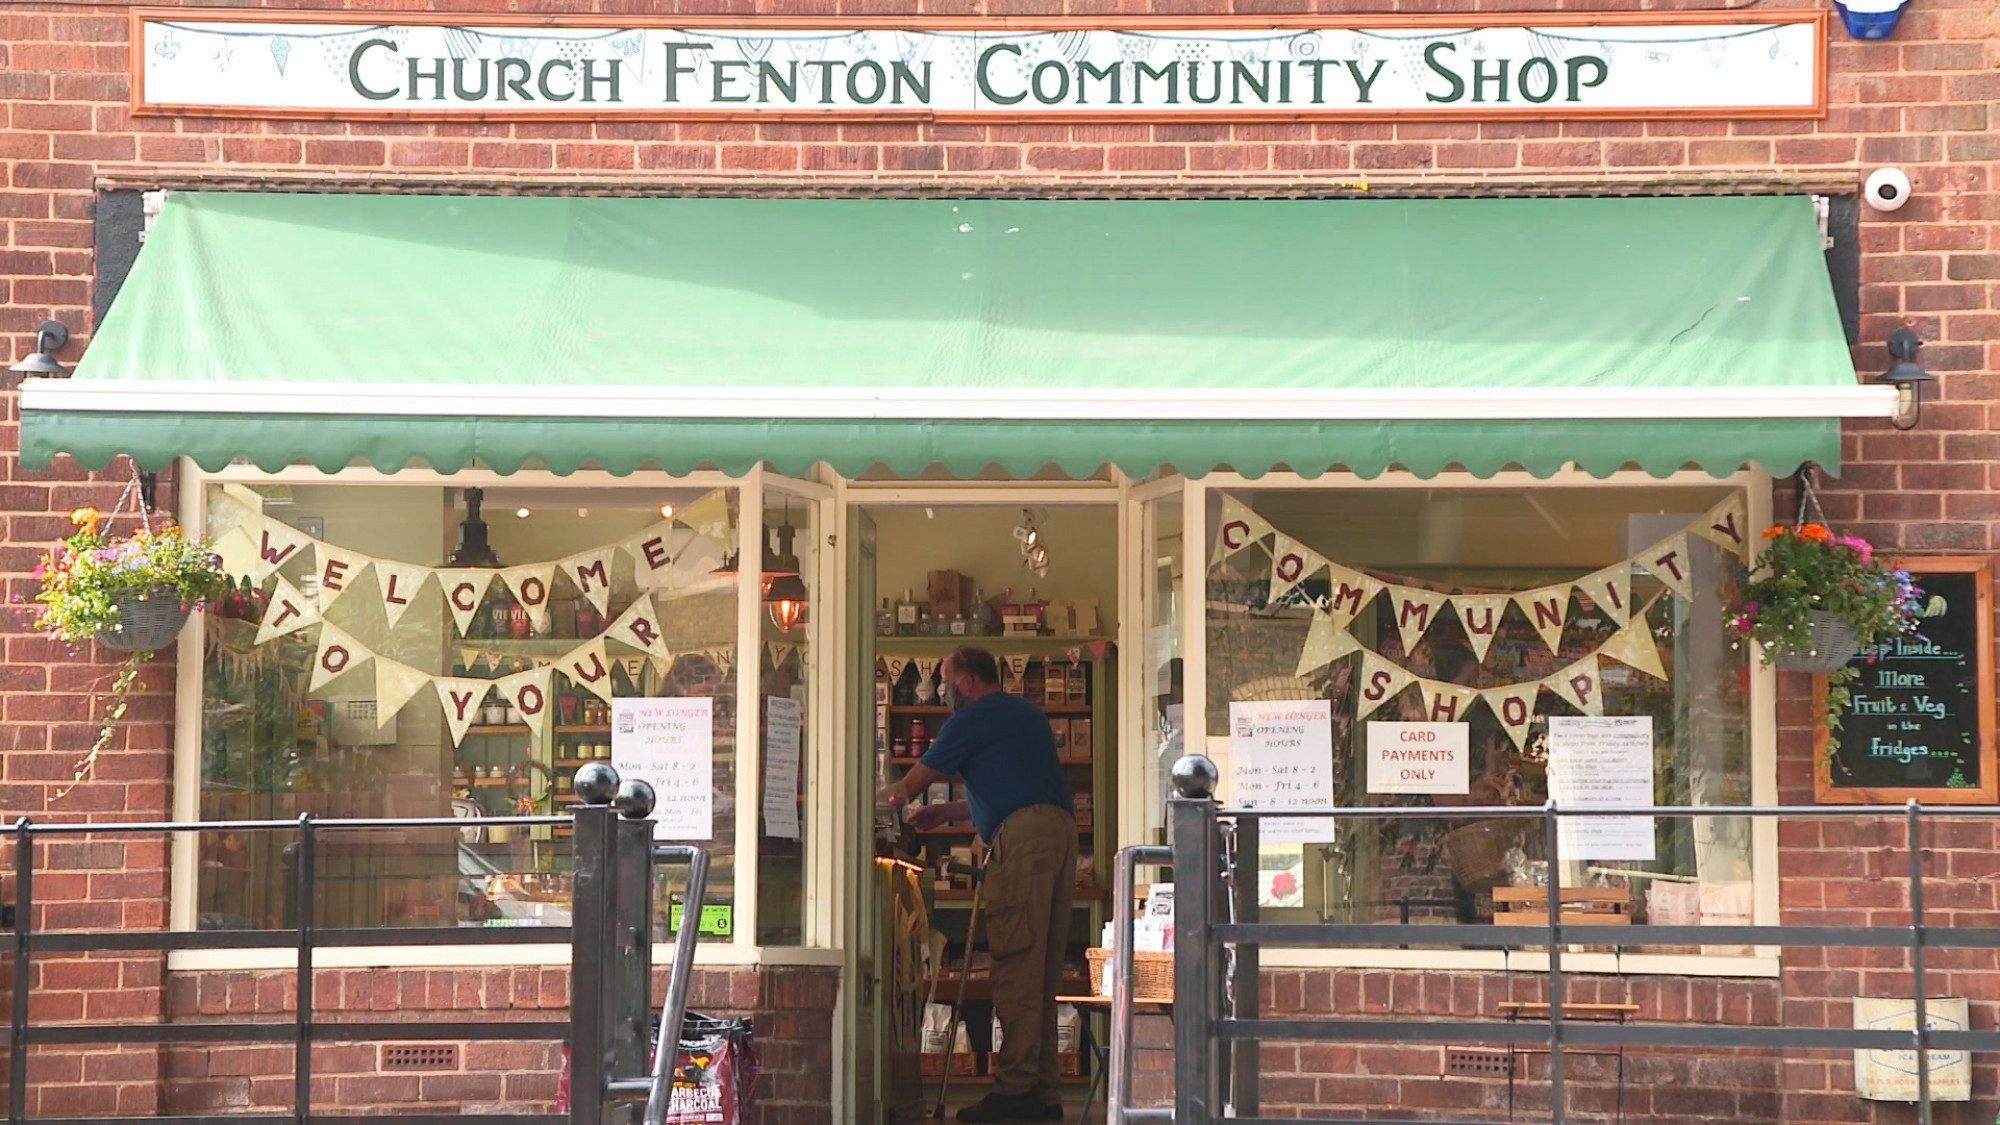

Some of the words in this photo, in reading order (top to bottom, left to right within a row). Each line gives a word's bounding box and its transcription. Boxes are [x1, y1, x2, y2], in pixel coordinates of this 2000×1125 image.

[347, 38, 622, 105] CHURCH
[664, 42, 934, 106] FENTON
[975, 43, 1386, 107] COMMUNITY
[1425, 41, 1609, 105] SHOP
[259, 529, 671, 611] WELCOME
[1223, 512, 1743, 635] COMMUNITY
[272, 602, 350, 674] TO
[451, 617, 660, 721] YOUR
[1878, 670, 1925, 686] More
[1364, 671, 1594, 727] SHOP
[1853, 694, 1897, 713] Fruit
[1912, 695, 1946, 719] Veg
[1399, 730, 1437, 742] CARD
[1382, 750, 1455, 761] PAYMENTS
[1400, 769, 1436, 780] ONLY
[670, 1084, 722, 1099] ARBECUE
[670, 1098, 723, 1112] HARCOAL
